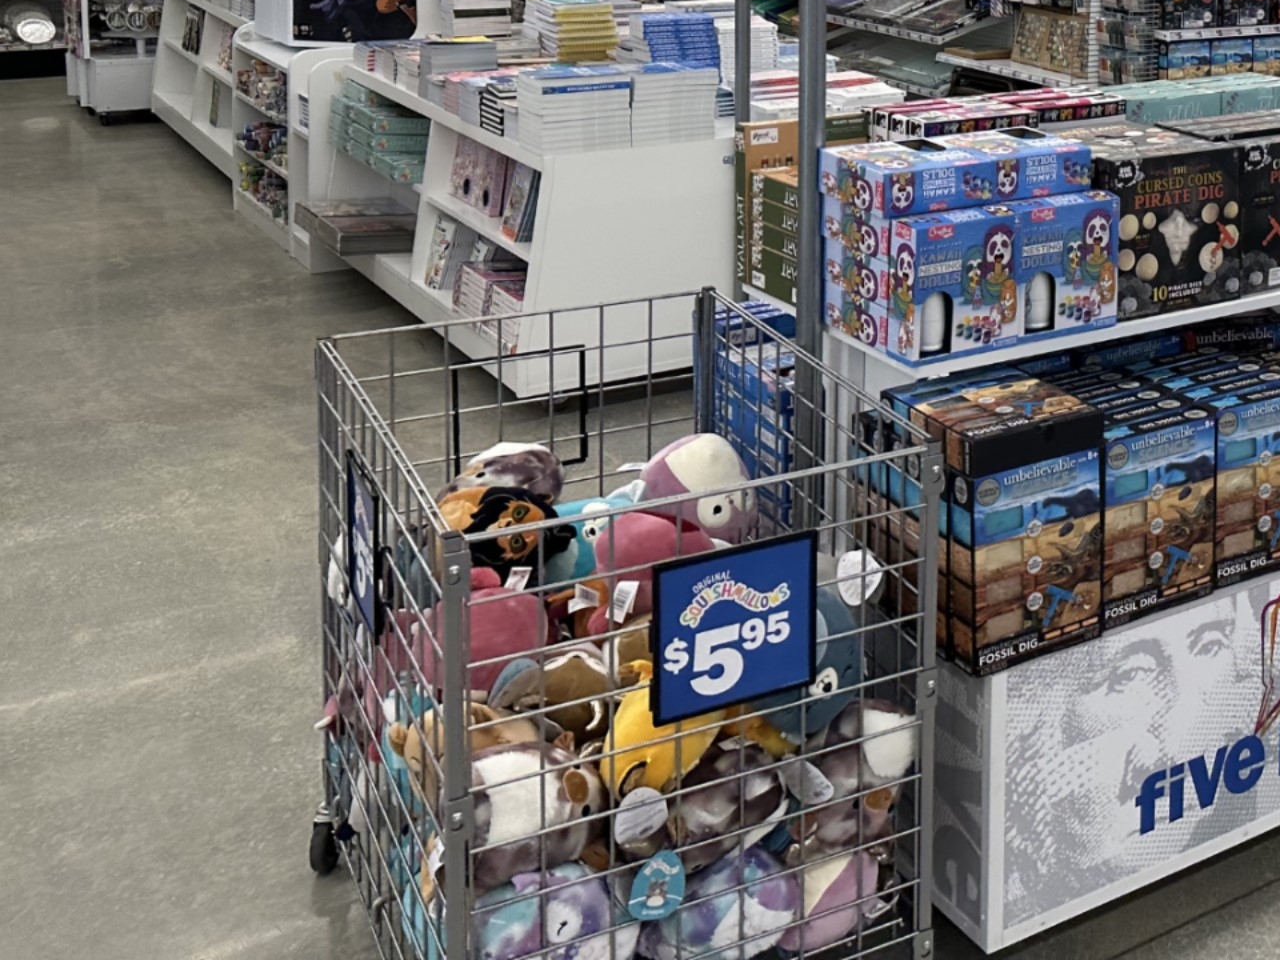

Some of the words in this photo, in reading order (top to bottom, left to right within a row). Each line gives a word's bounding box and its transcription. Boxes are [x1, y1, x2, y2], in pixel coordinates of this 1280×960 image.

[1172, 166, 1187, 175] THE
[1137, 174, 1184, 194] CURSED
[1187, 171, 1223, 187] COINS
[736, 194, 744, 223] ART
[1134, 191, 1191, 210] PIRATE
[1199, 186, 1224, 201] DIG
[736, 233, 745, 278] WALL
[1022, 242, 1063, 256] NESTING
[919, 261, 961, 276] NESTING
[1022, 254, 1062, 269] DOLLS
[919, 273, 961, 288] DOLLS
[1153, 284, 1167, 301] 10
[1196, 328, 1274, 346] unbelievable
[1131, 425, 1195, 451] unbelievable
[1204, 419, 1214, 429] 8+
[1003, 458, 1077, 487] unbelievable
[1087, 451, 1098, 460] 8+
[1217, 563, 1248, 578] FOSSIL
[1250, 557, 1267, 569] DIG
[692, 570, 731, 593] ORIGINAL
[680, 581, 790, 628] SQUISHMALLOWS
[1104, 601, 1138, 620] FOSSIL
[1140, 594, 1157, 609] DIG
[979, 646, 1016, 667] FOSSIL
[1018, 638, 1038, 653] DIG
